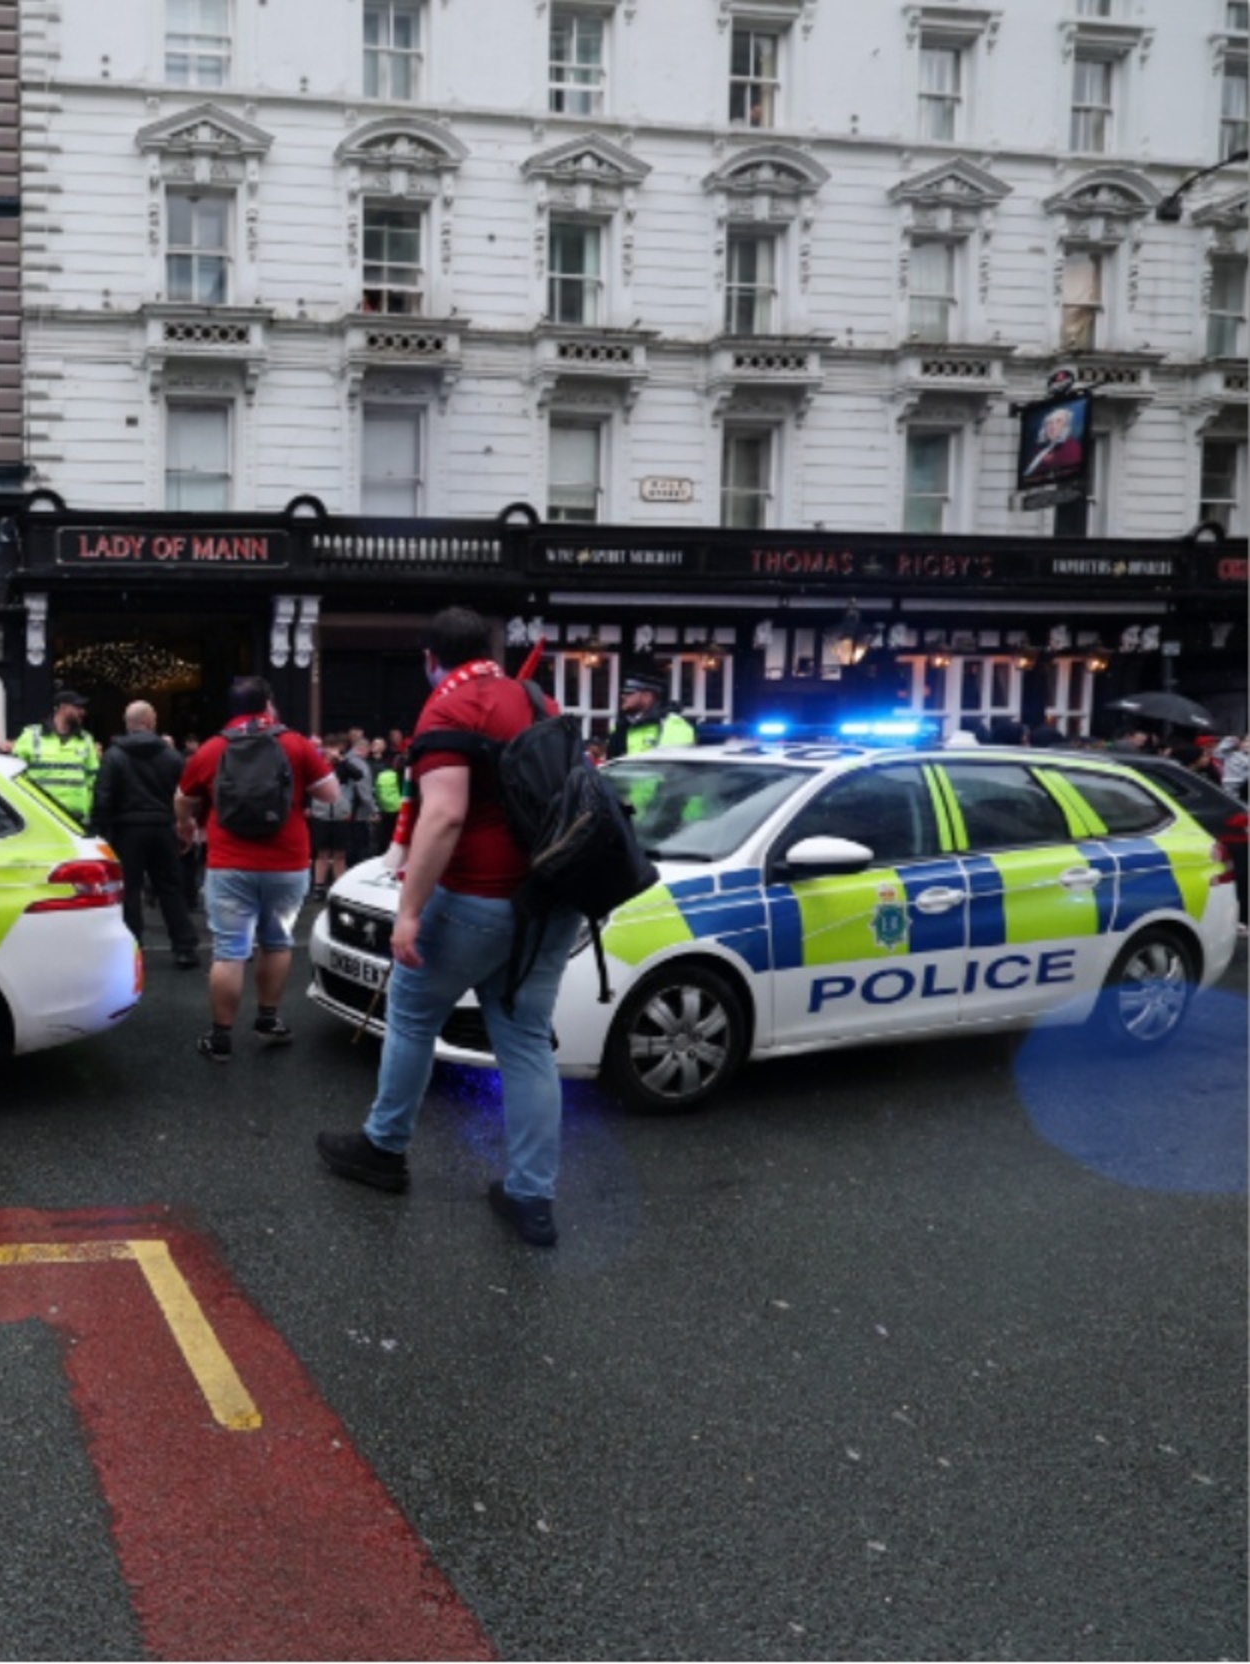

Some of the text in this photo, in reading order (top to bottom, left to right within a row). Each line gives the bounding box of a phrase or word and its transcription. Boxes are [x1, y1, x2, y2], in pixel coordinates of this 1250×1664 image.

[78, 534, 268, 560] LADY OF MANN
[751, 550, 993, 578] THOMAS RIGBY'S
[806, 948, 1077, 1013] POLICE
